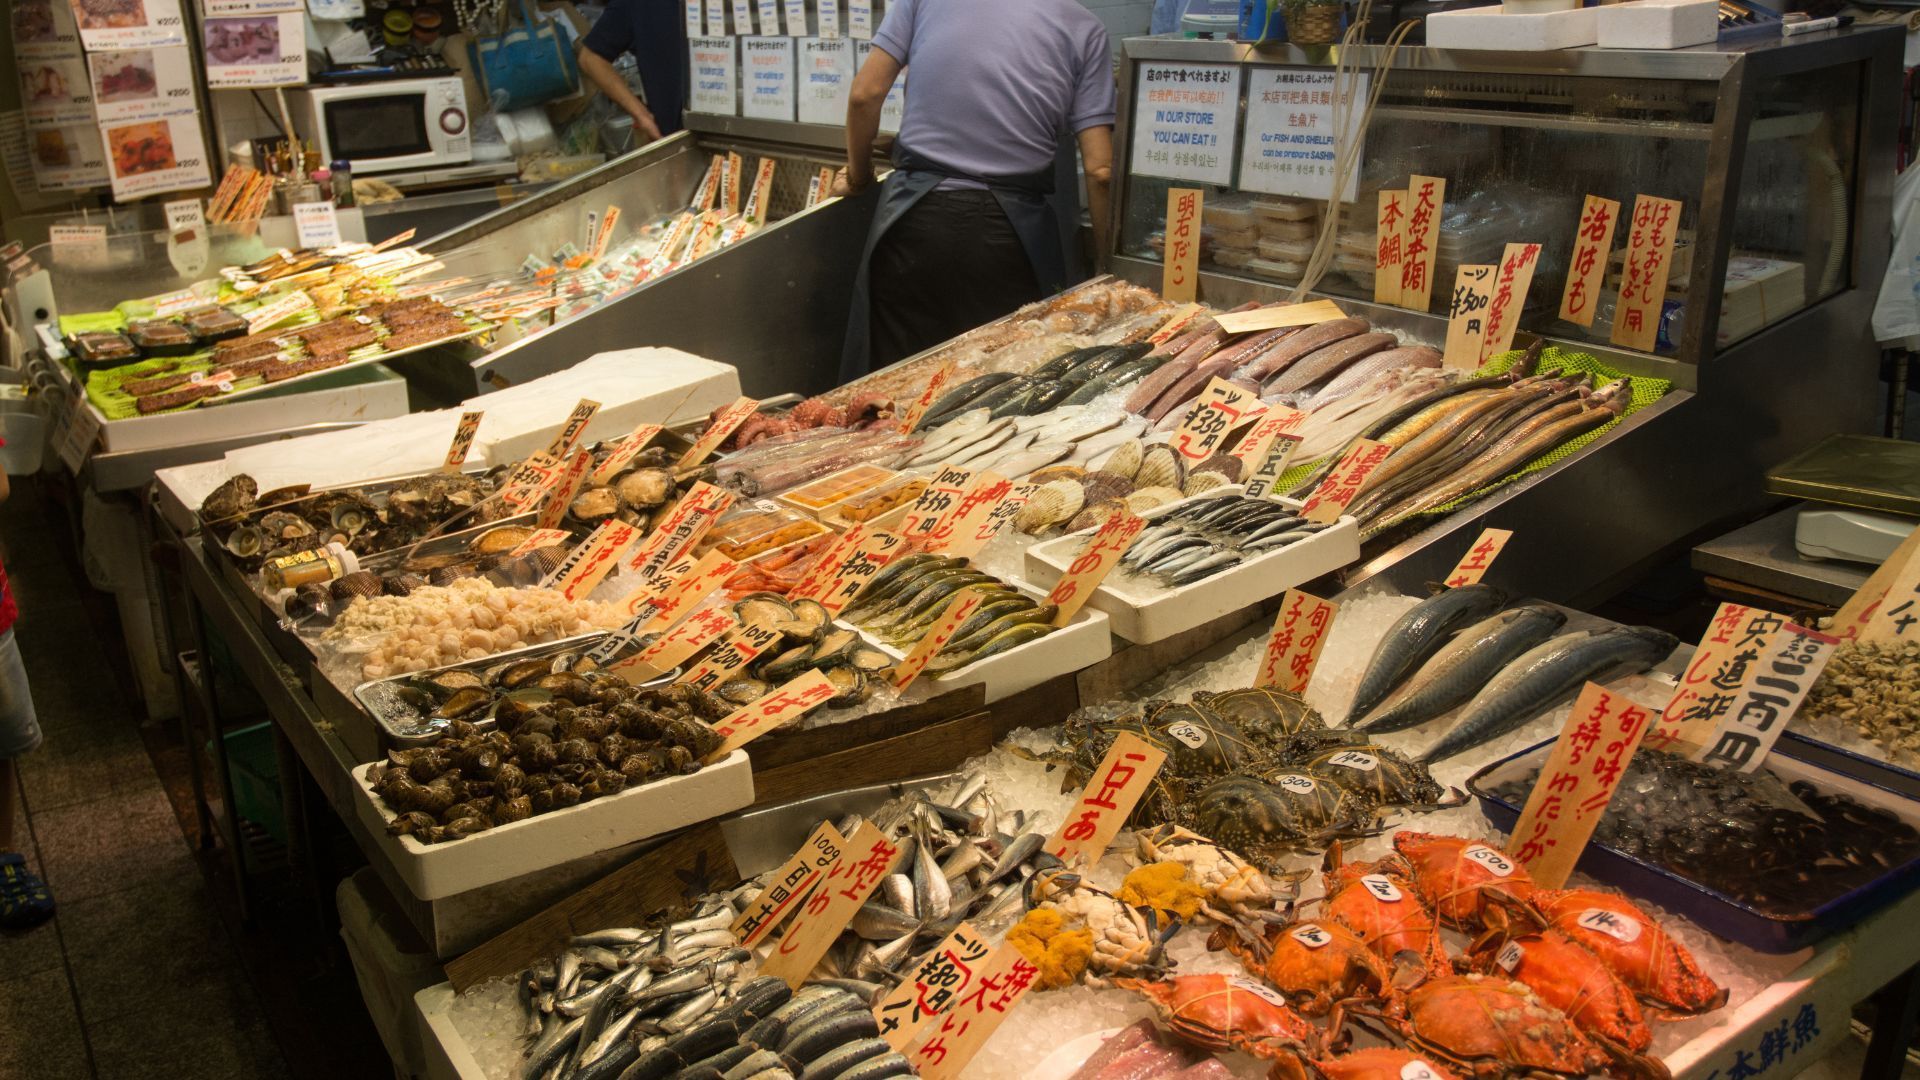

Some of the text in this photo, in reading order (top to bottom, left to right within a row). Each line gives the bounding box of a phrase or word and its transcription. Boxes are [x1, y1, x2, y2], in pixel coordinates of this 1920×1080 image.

[1153, 131, 1170, 143] YOU
[1172, 132, 1190, 144] CAN
[1191, 133, 1209, 145] EAT
[1156, 111, 1214, 125] IN OUR STORE
[1274, 133, 1289, 143] FISH
[1290, 134, 1305, 144] AND
[1287, 112, 1319, 128] 生魚片
[1173, 192, 1195, 286] 明石だこ
[1376, 194, 1404, 270] 本鯛
[1568, 203, 1611, 315] 活はも
[1642, 203, 1672, 304] はもおとし
[813, 834, 842, 868] 100g
[779, 857, 858, 955] いわし
[915, 953, 960, 989] ¥80
[917, 972, 997, 1070] 大いわ
